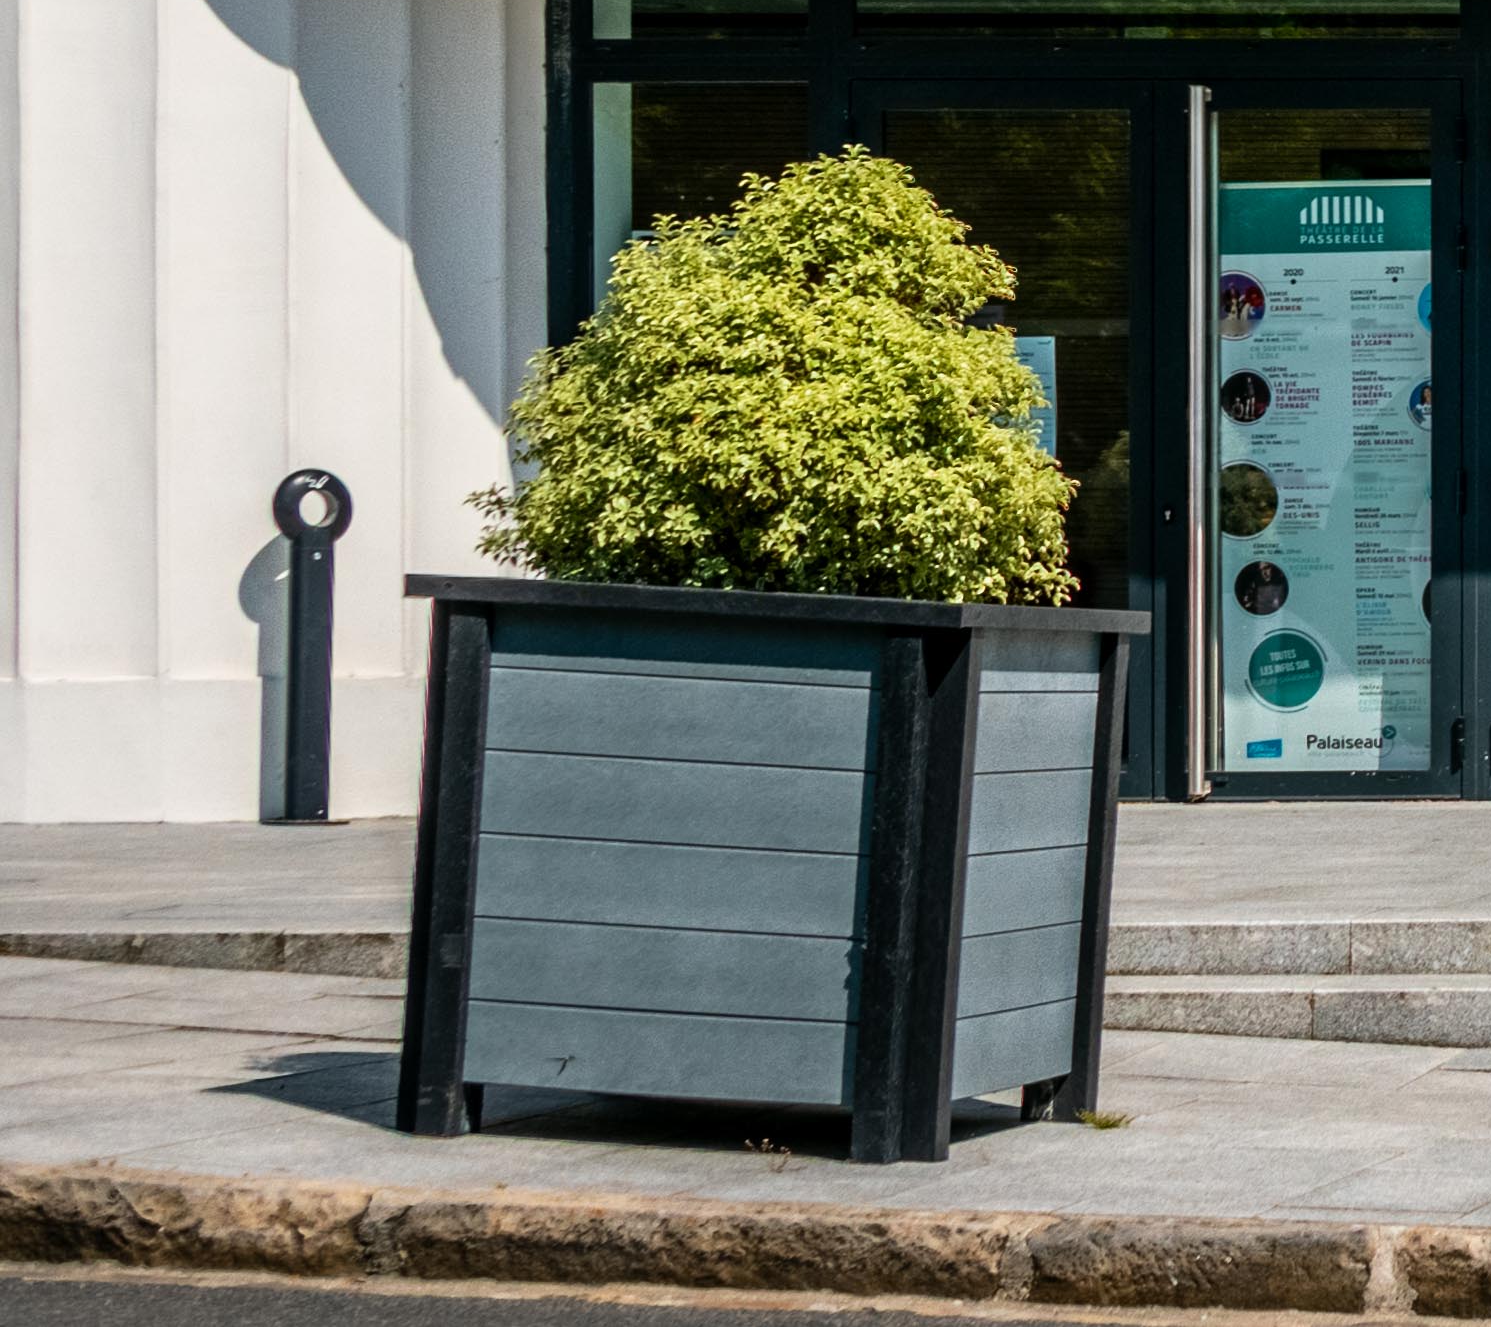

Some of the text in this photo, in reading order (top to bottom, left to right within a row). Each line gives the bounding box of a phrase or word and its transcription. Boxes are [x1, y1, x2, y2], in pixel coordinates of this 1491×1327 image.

[1300, 233, 1385, 244] PASSERELLE
[1283, 268, 1304, 277] 2020
[1385, 266, 1405, 275] 2021
[1306, 734, 1383, 750] Palaiseau
